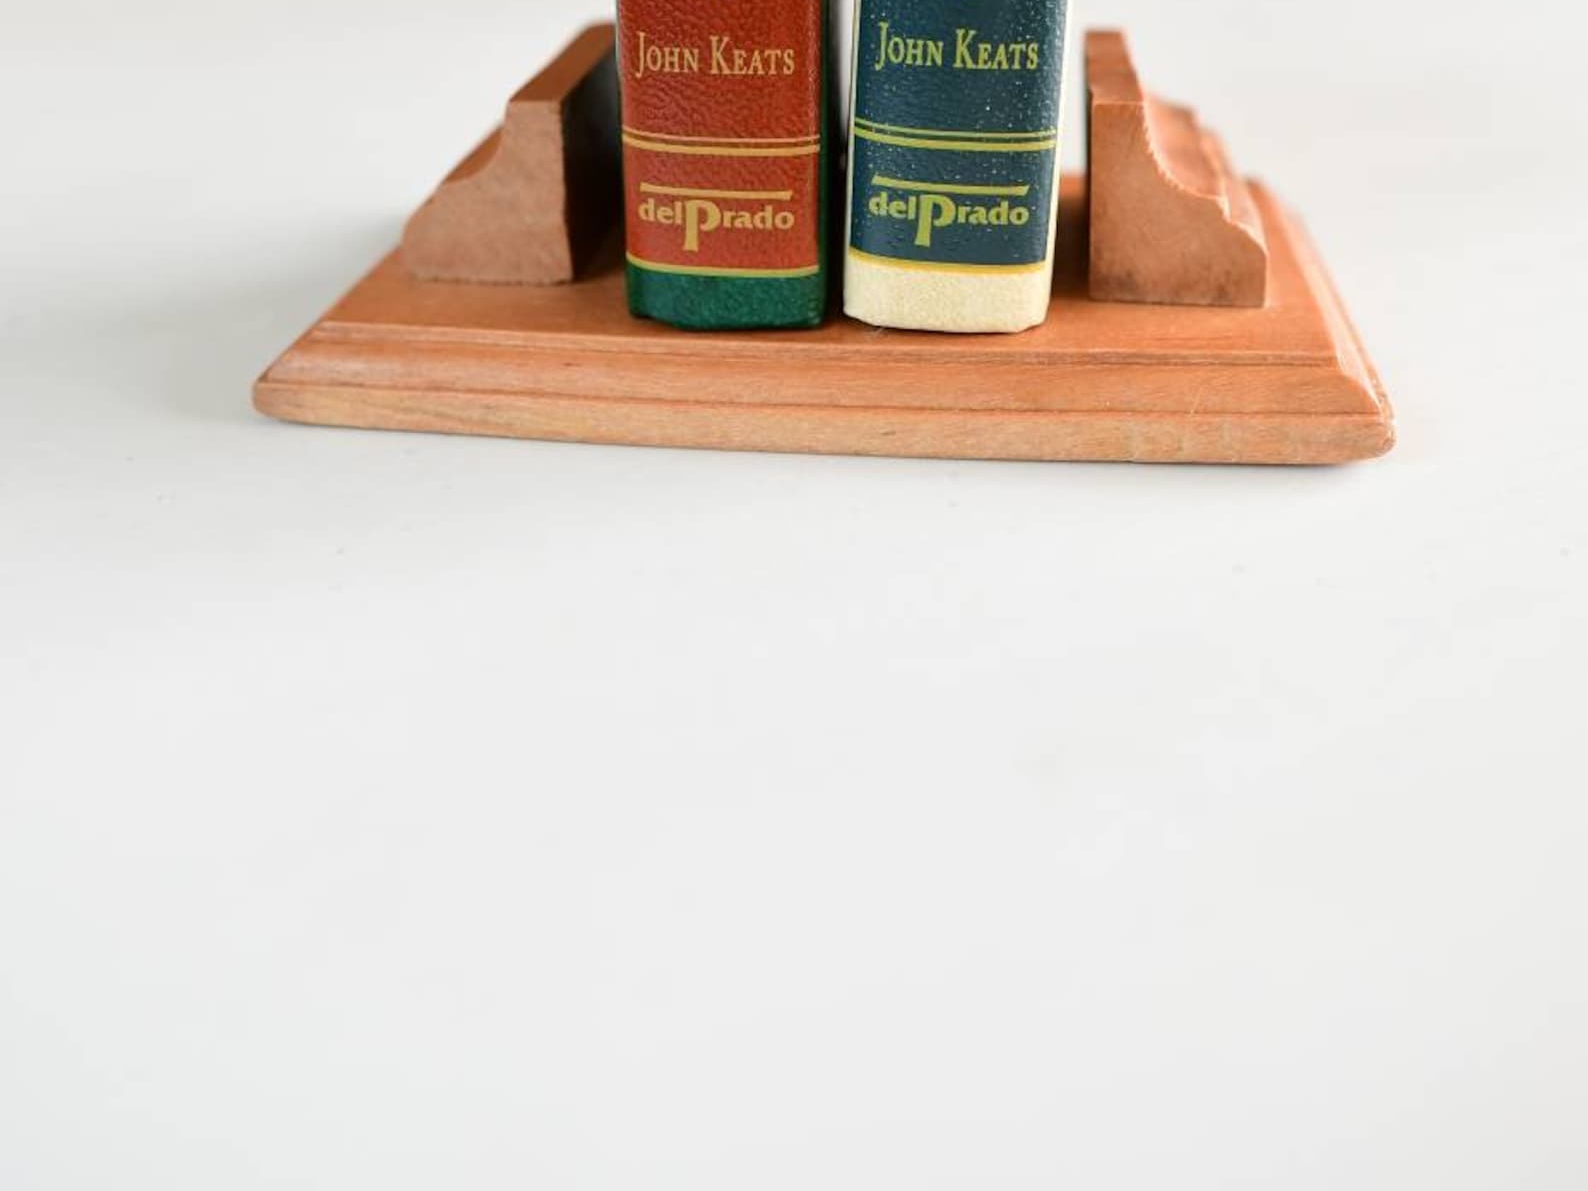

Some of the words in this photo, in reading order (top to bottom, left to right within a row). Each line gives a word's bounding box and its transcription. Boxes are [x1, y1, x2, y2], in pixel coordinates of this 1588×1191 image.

[635, 30, 699, 78] JOHN
[709, 36, 795, 76] KEATS
[875, 22, 943, 71] JOHN
[952, 28, 1039, 70] KEATS
